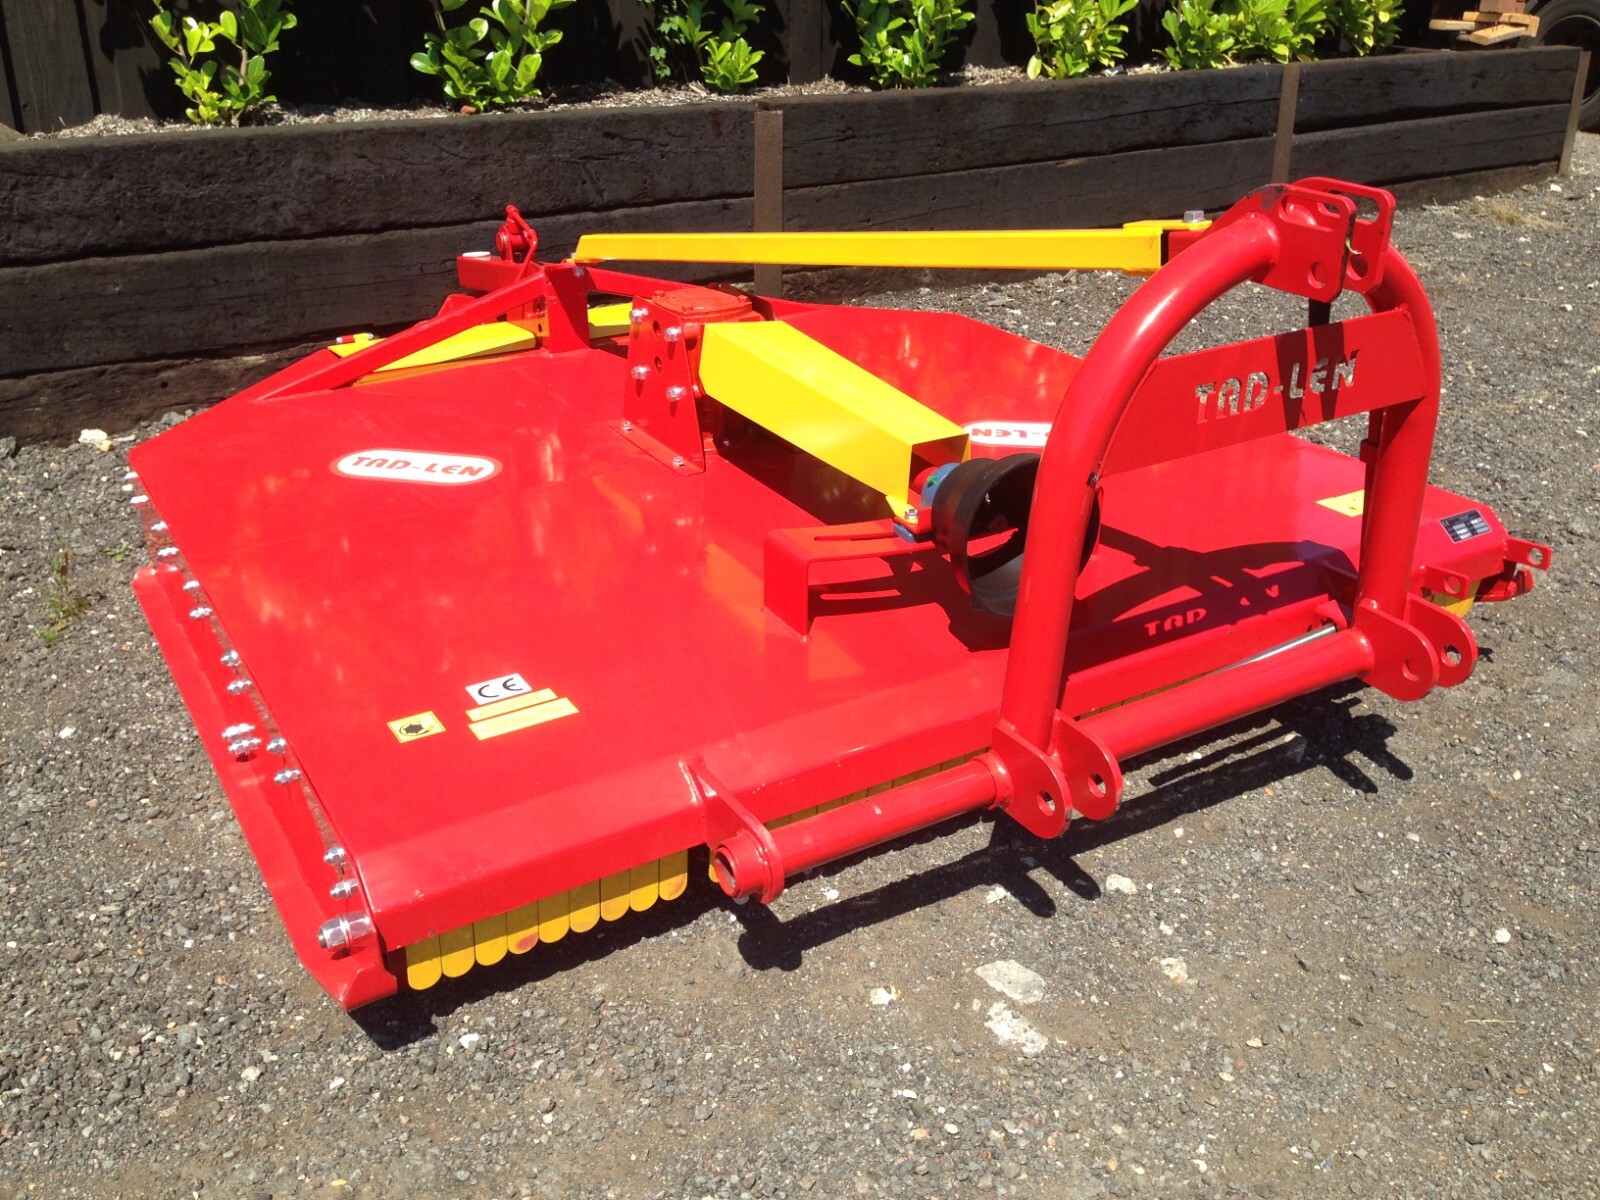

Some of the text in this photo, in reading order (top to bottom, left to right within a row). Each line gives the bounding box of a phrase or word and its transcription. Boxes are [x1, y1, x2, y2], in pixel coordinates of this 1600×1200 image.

[1195, 349, 1361, 424] TAD-LEN
[971, 428, 1050, 438] -LEN
[351, 456, 485, 477] TAD-LEN
[477, 677, 523, 698] CE
